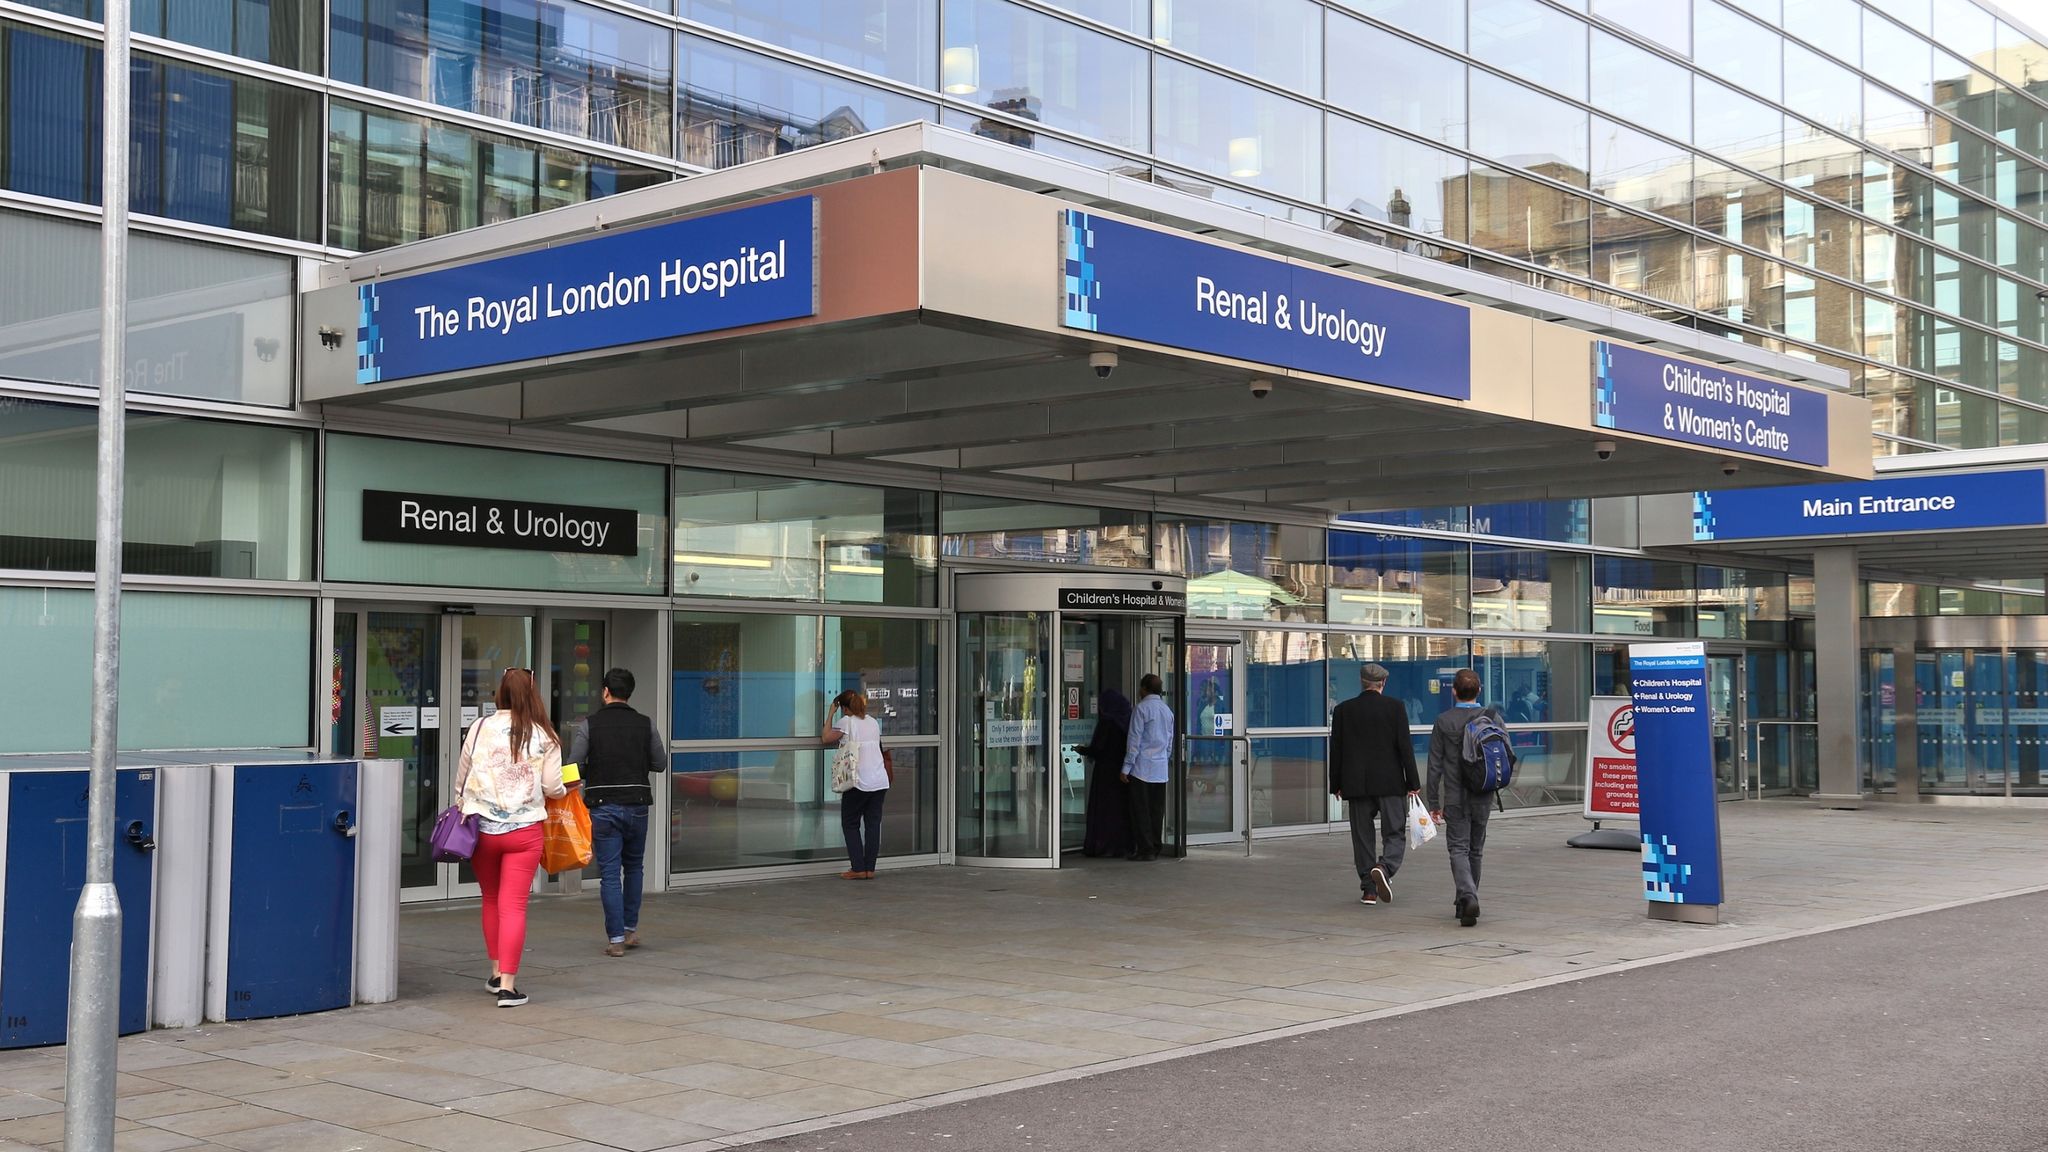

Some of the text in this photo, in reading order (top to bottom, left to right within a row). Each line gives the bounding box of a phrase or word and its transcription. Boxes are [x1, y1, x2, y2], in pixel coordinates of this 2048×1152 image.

[415, 239, 785, 340] The Royal London Hospital
[1196, 276, 1386, 358] Renal & Urology
[1663, 363, 1791, 417] Children's Hospital
[1664, 403, 1789, 452] & Women's Centre
[1803, 495, 1956, 518] Main Entrance
[401, 500, 610, 547] Renal & Urology
[1066, 592, 1120, 605] Children's
[1122, 594, 1158, 608] Hospital
[1158, 595, 1164, 606] &
[1634, 620, 1651, 632] Food
[1677, 658, 1699, 667] Hospital
[1640, 679, 1702, 688] Children's Hospital
[1640, 692, 1657, 700] Renal
[1665, 692, 1693, 701] Urology
[1641, 705, 1696, 713] Women's Centre
[1609, 763, 1637, 772] smoking
